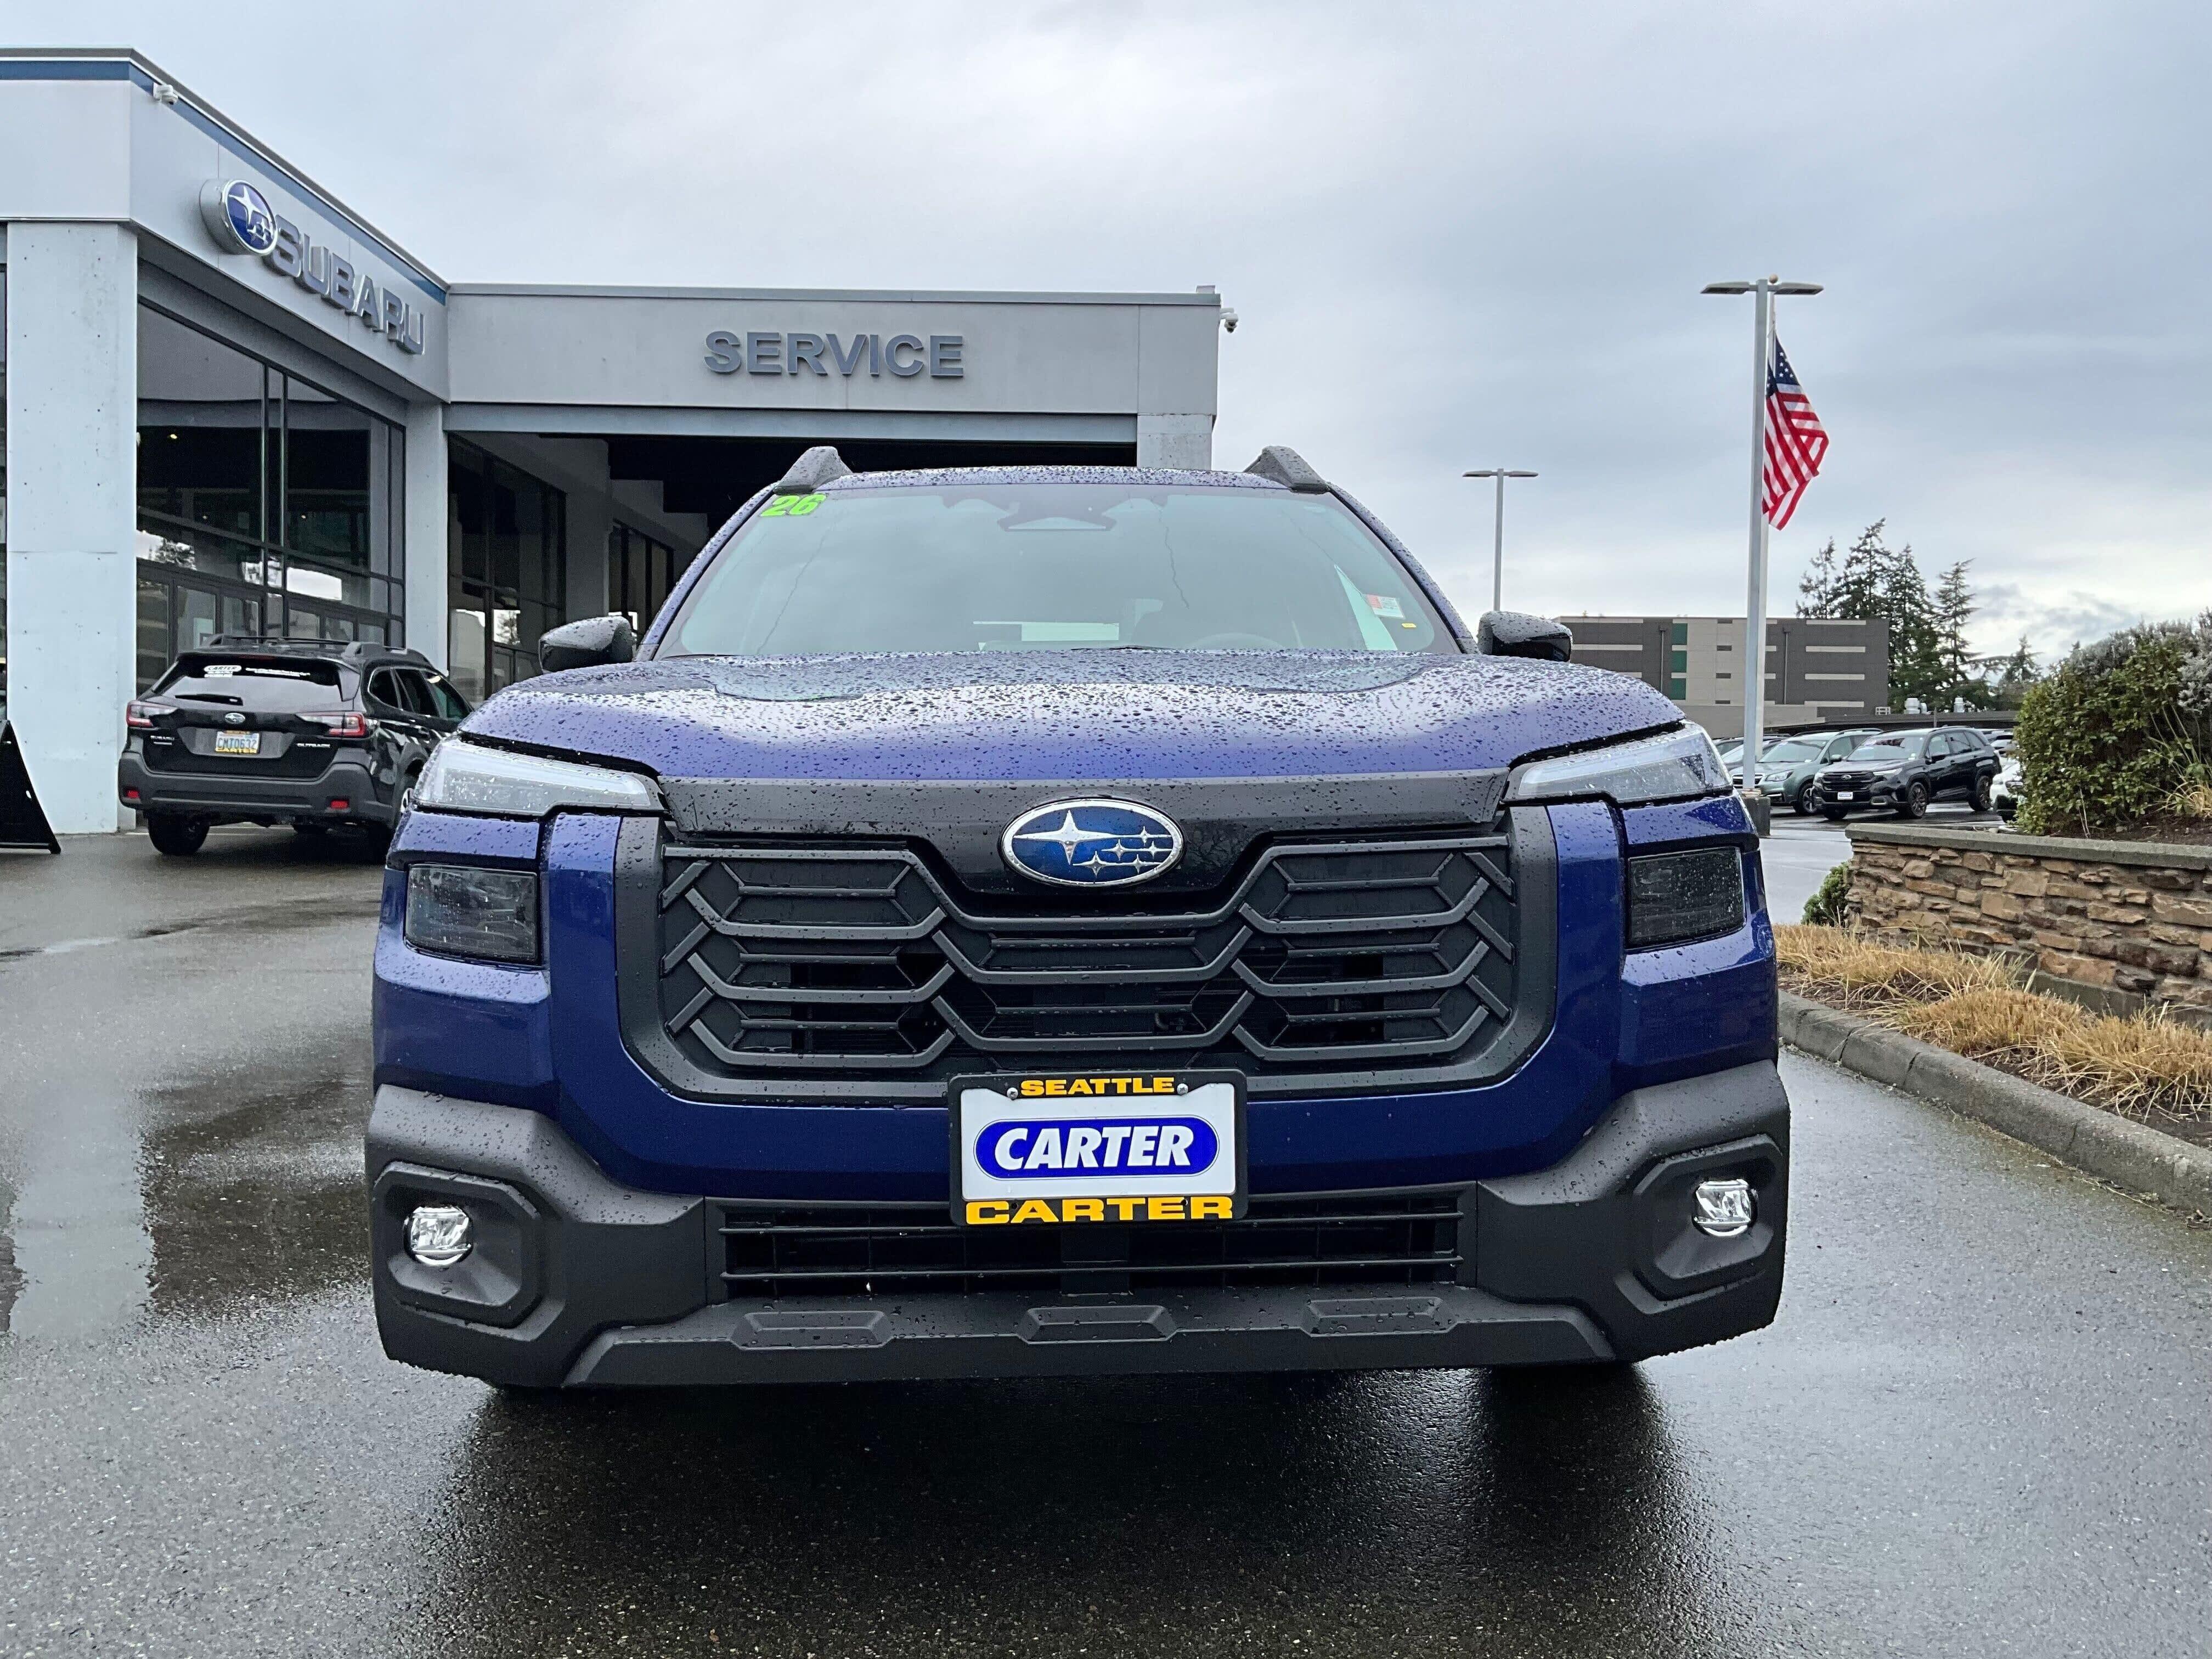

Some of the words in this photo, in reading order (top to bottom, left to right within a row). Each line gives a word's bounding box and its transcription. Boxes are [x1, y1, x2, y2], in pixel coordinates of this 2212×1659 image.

[272, 215, 425, 356] SUBARU
[704, 330, 964, 378] SERVICE
[760, 494, 826, 517] 26
[1020, 1077, 1175, 1096] SEATTLE
[994, 1125, 1194, 1170] CARTER
[966, 1196, 1233, 1224] CARTER
